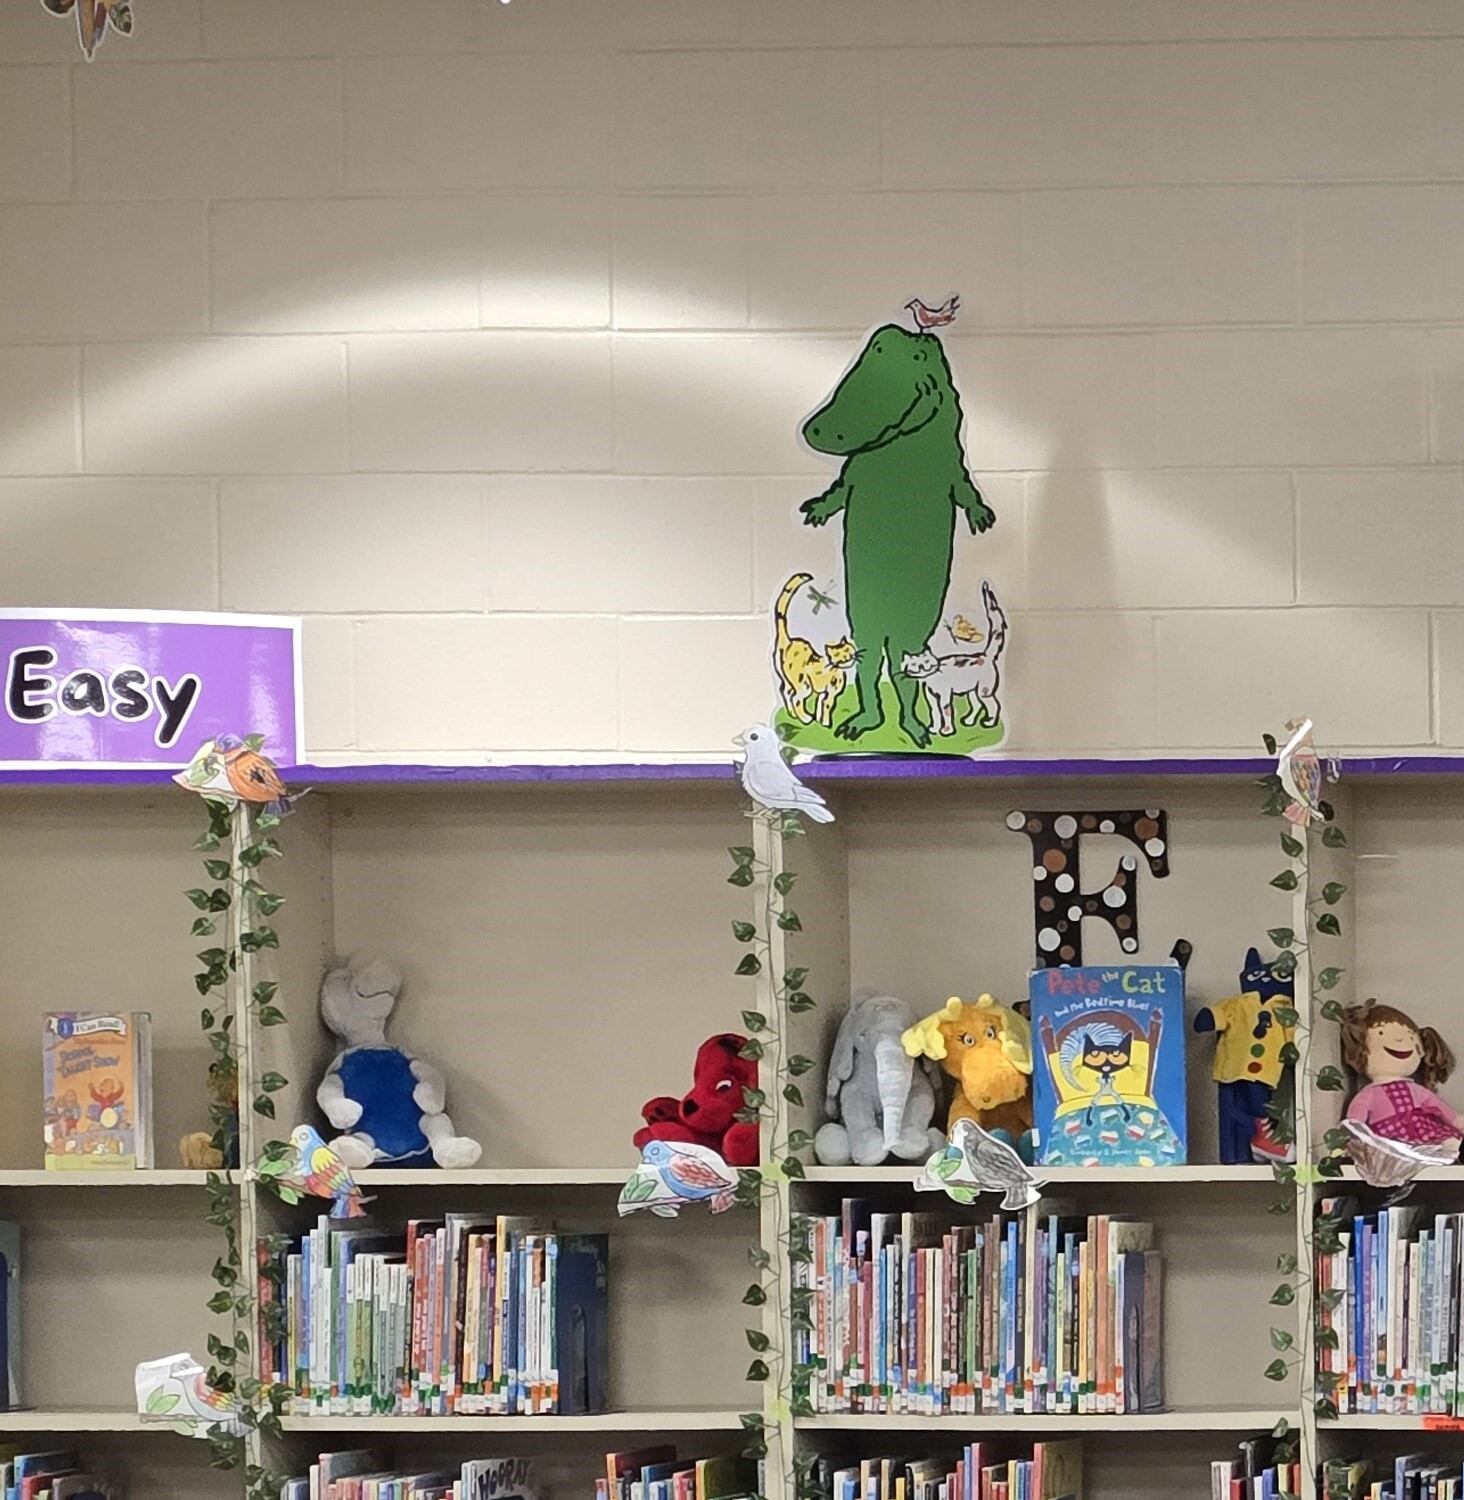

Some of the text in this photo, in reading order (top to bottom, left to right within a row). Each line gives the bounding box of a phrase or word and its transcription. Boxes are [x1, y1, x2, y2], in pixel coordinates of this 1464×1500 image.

[8, 647, 199, 746] Easy
[1048, 969, 1166, 996] Pete the Cat
